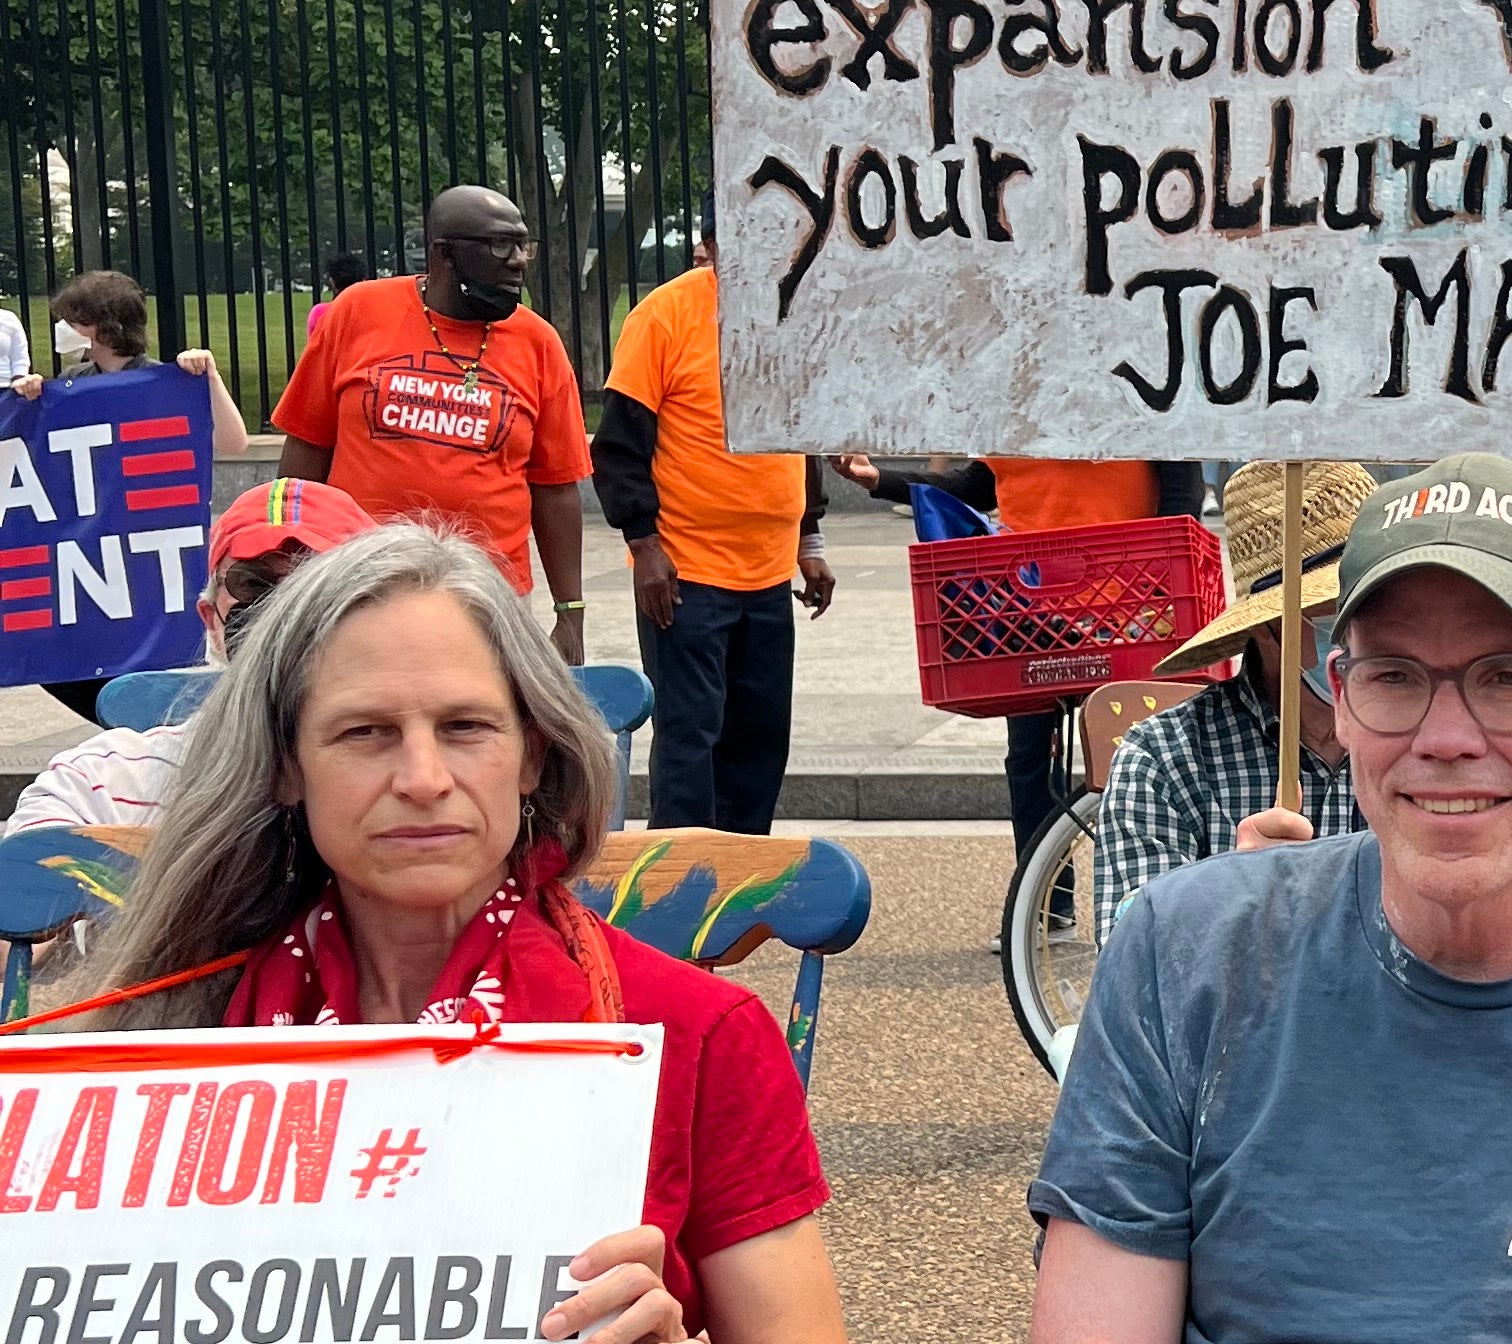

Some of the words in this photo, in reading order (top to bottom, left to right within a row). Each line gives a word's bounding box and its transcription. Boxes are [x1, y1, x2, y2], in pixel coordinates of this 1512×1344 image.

[749, 136, 1032, 323] your
[390, 375, 438, 396] NEW
[441, 381, 492, 407] YORK
[1113, 270, 1318, 412] JOE
[382, 404, 489, 440] CHANGE
[0, 1079, 347, 1213] LATION
